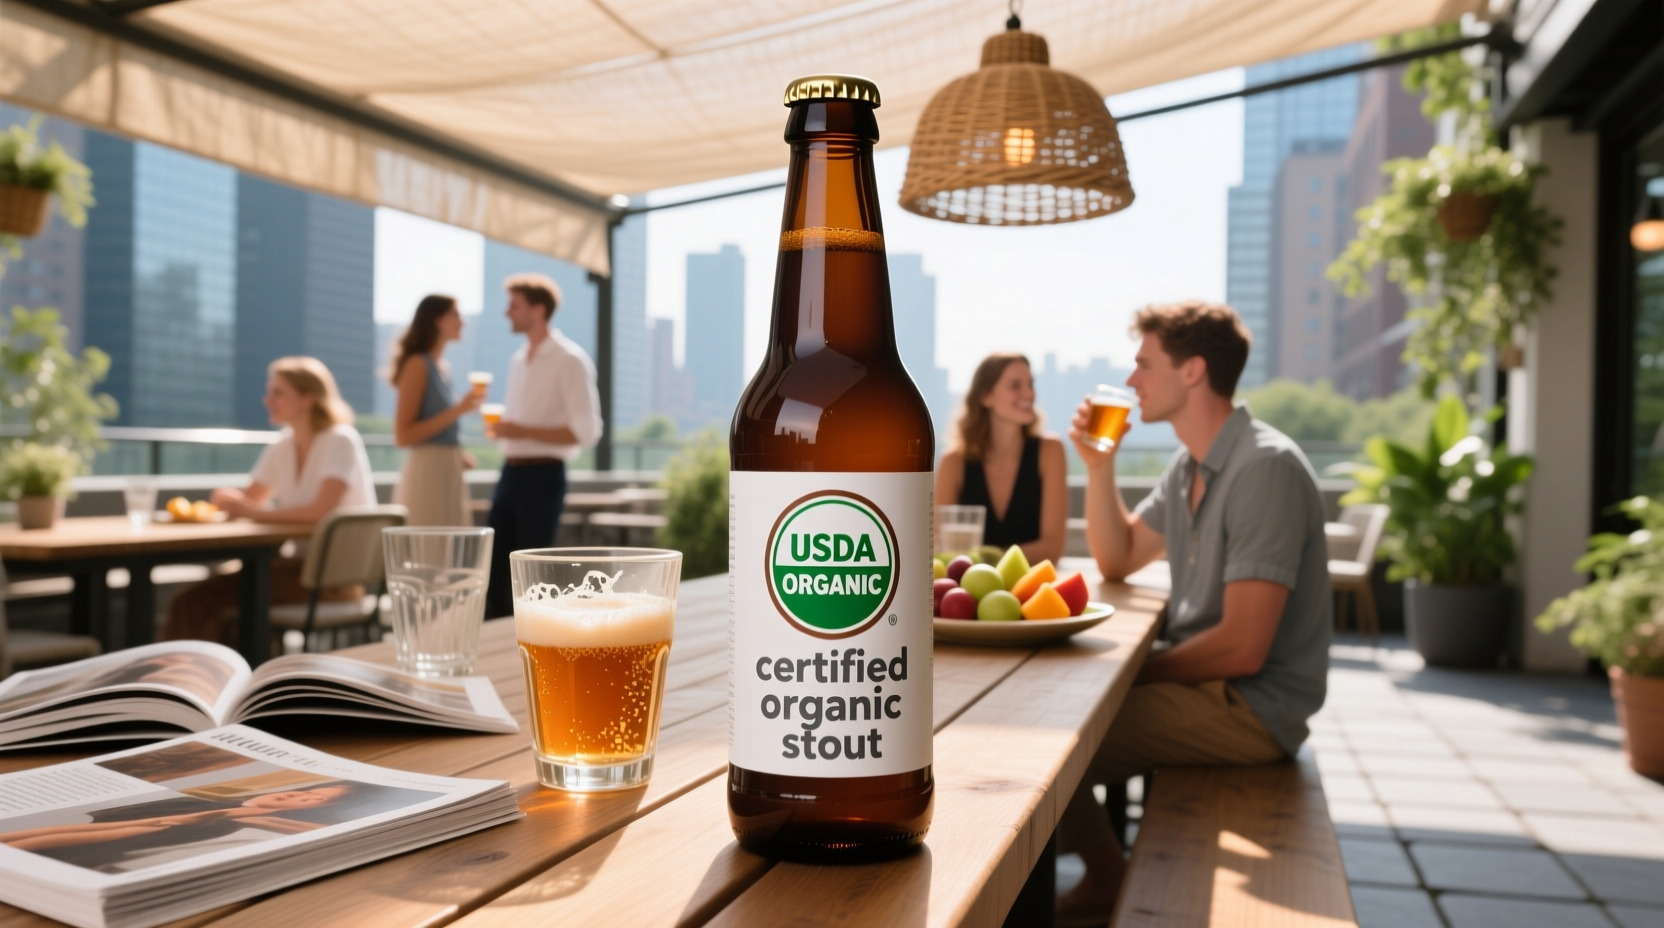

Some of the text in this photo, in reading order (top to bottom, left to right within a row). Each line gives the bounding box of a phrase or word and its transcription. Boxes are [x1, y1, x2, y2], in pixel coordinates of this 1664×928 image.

[791, 533, 876, 563] USDA
[782, 573, 882, 596] ORGANIC
[756, 646, 908, 683] certified
[760, 685, 902, 731] organic
[782, 728, 883, 761] stout
